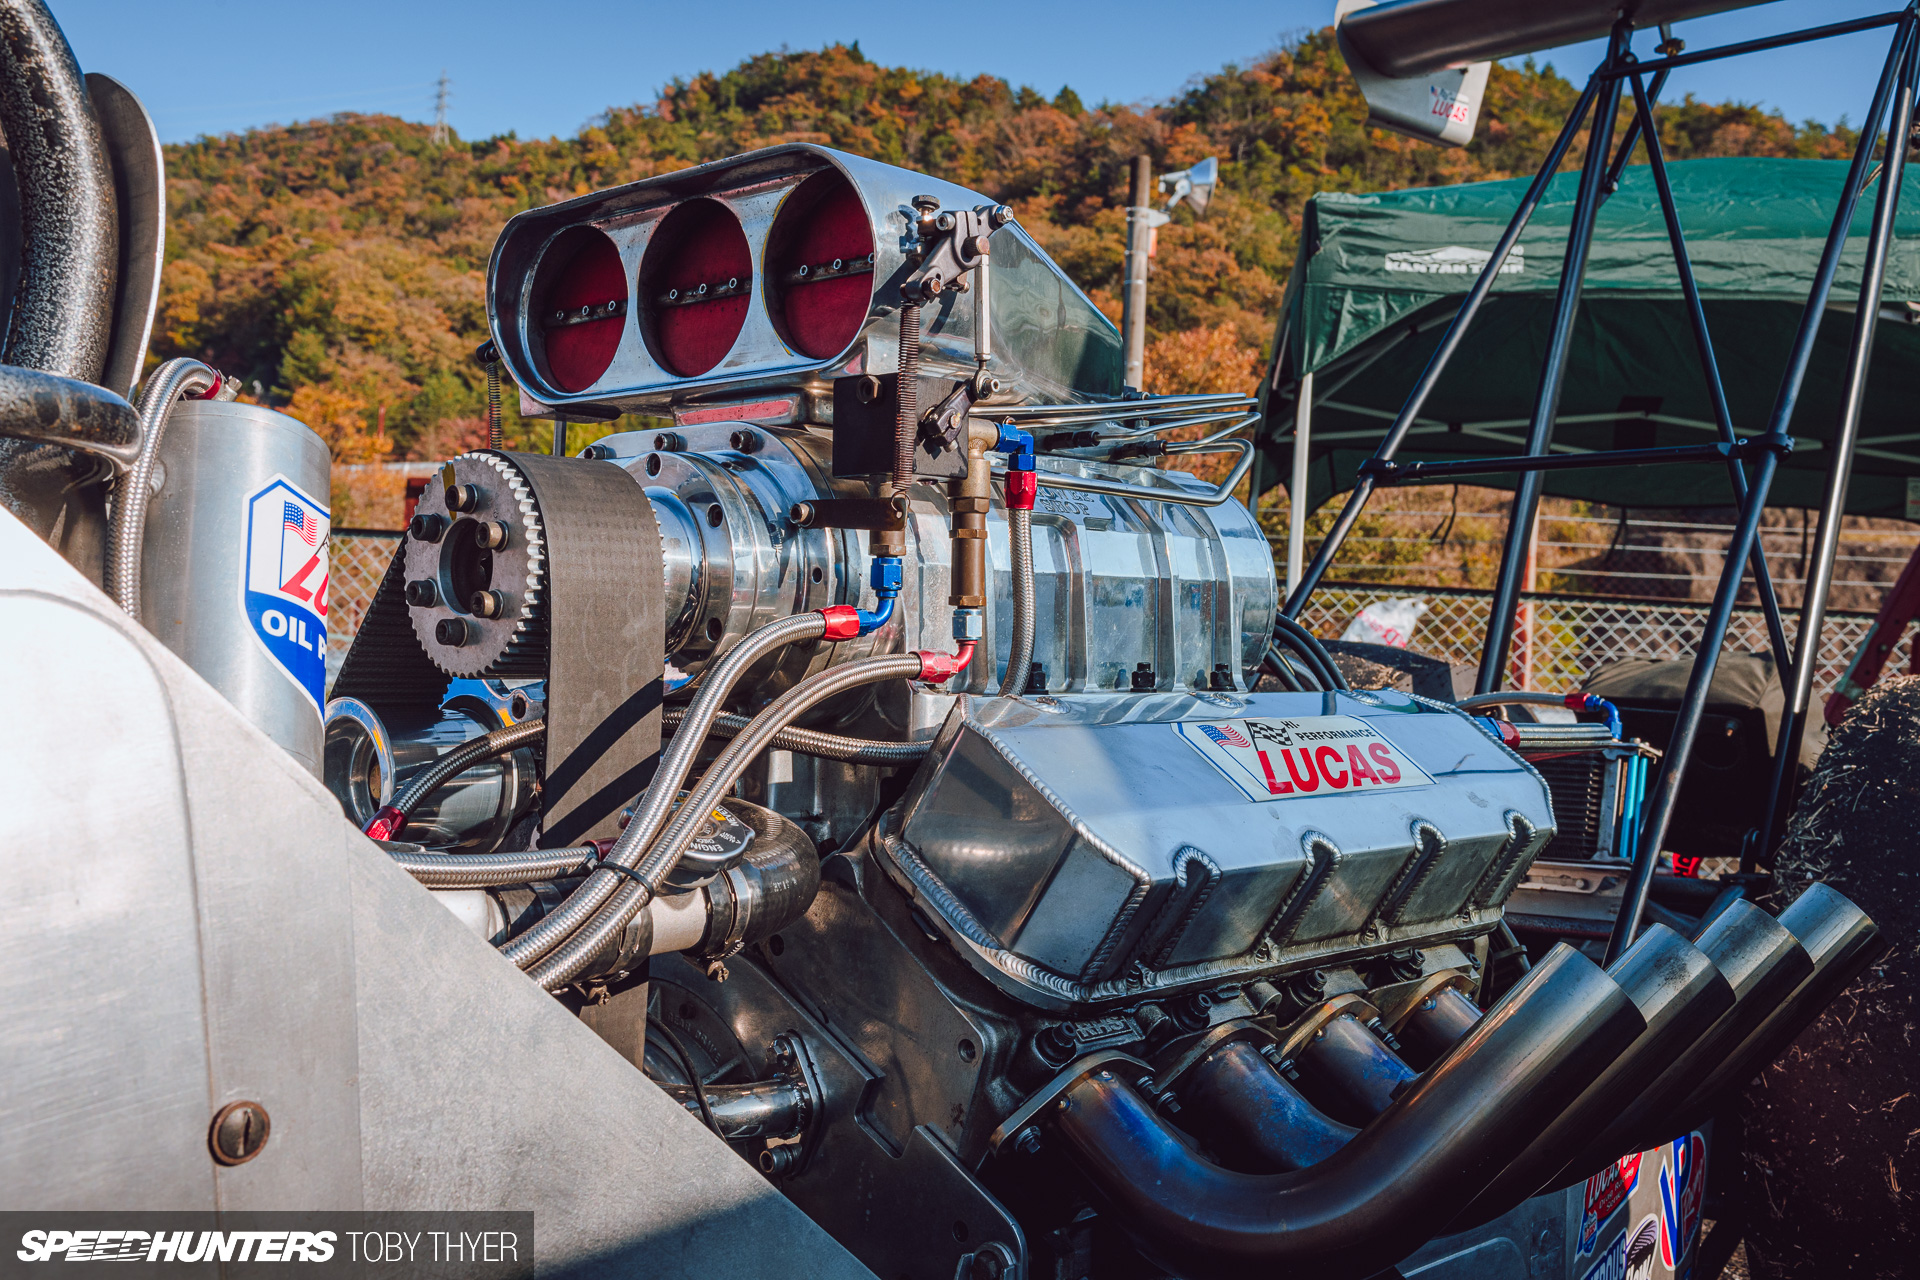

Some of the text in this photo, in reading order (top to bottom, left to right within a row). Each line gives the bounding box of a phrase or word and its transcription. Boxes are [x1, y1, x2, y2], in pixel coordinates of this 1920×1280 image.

[1432, 98, 1468, 122] LUCAS
[261, 608, 313, 652] OIL
[1296, 728, 1376, 741] PERFORMANCE
[1257, 742, 1401, 795] LUCAS
[690, 842, 725, 852] ENGIN
